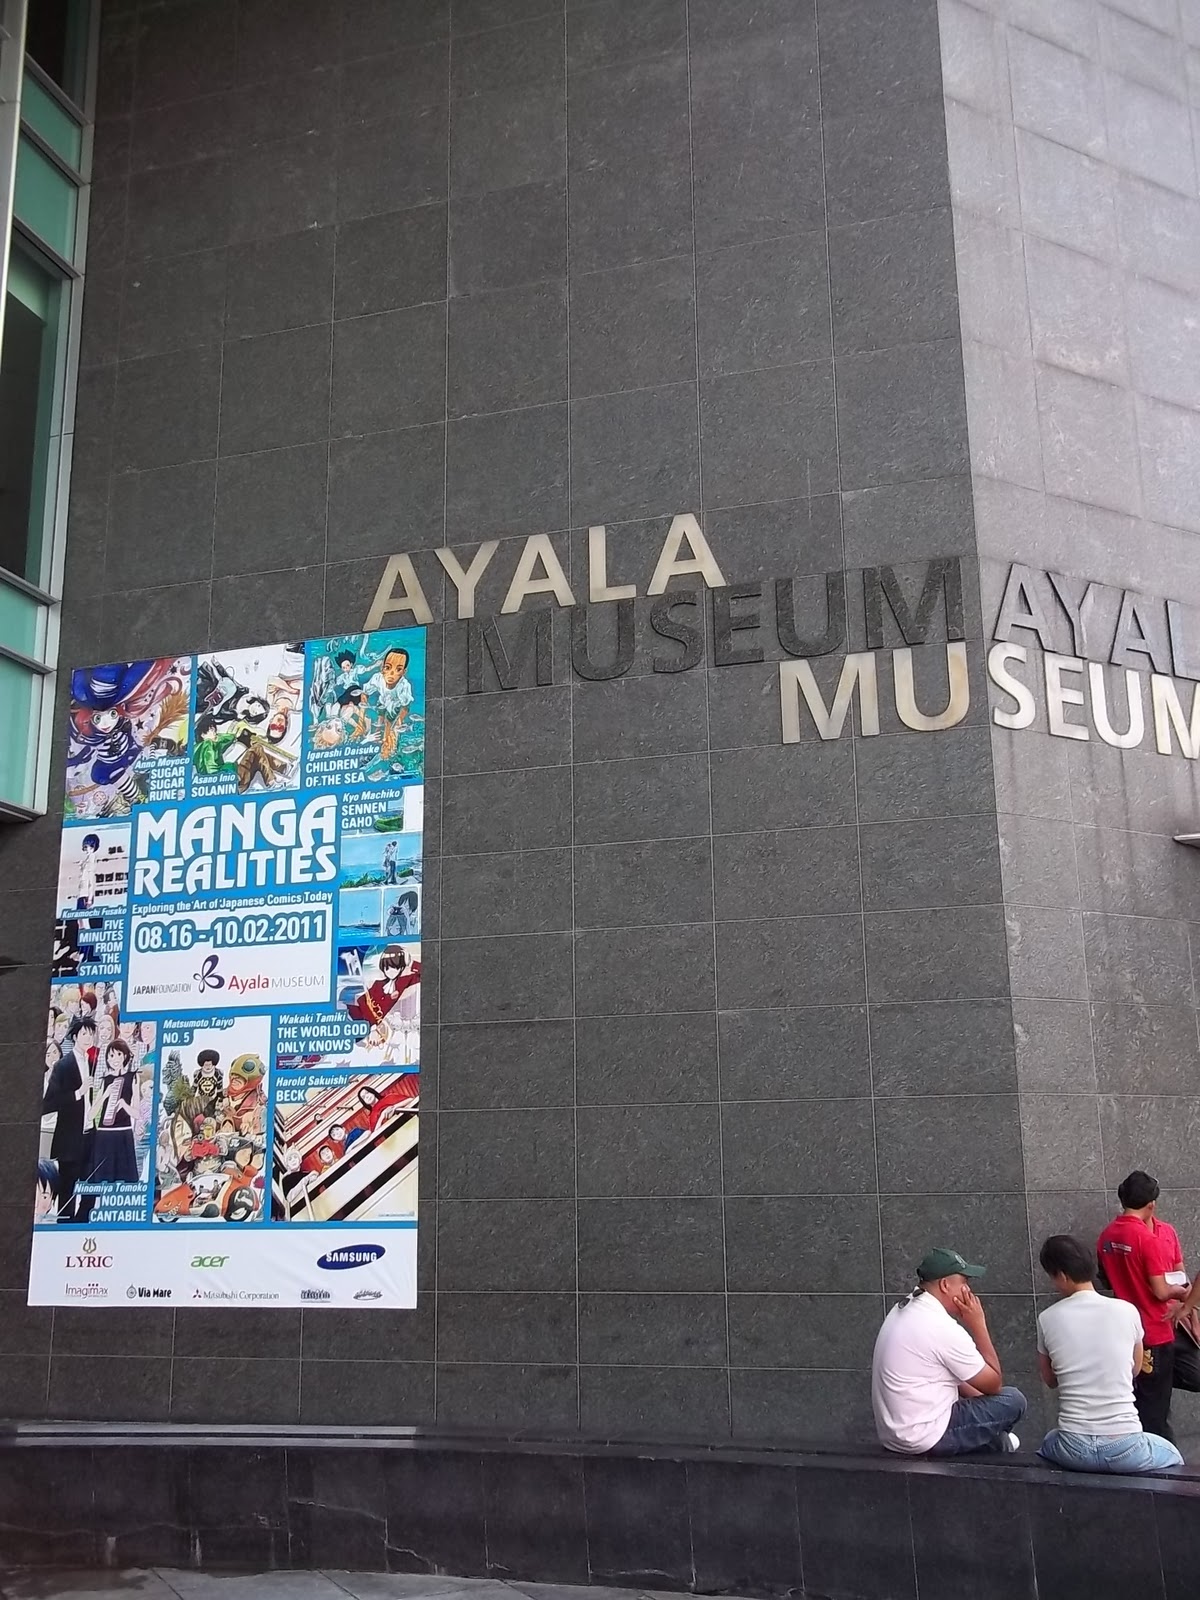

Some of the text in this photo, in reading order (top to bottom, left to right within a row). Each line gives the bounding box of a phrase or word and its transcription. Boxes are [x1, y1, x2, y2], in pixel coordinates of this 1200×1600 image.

[362, 513, 726, 632] AYALA
[468, 556, 965, 694] MUSEUM
[307, 745, 380, 761] Igarashi Daisuke
[135, 756, 190, 770] Anno Moyoco
[306, 758, 358, 773] CHILDREN
[151, 767, 185, 779] SUGAR
[192, 775, 217, 784] Asano
[306, 772, 365, 787] OF THE SEA
[150, 777, 185, 790] SUGAR
[150, 789, 177, 801] RUNE
[191, 784, 236, 797] SOLANIN
[342, 790, 400, 803] Kyo Machiko
[342, 802, 387, 816] SENNEN
[136, 795, 338, 860] MANGA
[342, 816, 372, 829] GAHO
[134, 845, 336, 898] REALITIES
[132, 891, 333, 916] Exploring the Art of Japanese Comics Today
[104, 919, 124, 930] FIVE
[79, 930, 123, 943] MINUTES
[95, 941, 123, 953] FROM
[101, 952, 120, 964] THE
[79, 963, 121, 976] STATION
[163, 1017, 234, 1029] Matsumoto Taiyo
[279, 1012, 346, 1025] Wakaki Tamiki
[277, 1024, 368, 1039] THE WORLD GOD
[277, 1039, 351, 1054] ONLY KNOWS
[276, 1074, 347, 1087] Harold Sakuishi
[277, 1089, 305, 1102] BECK
[74, 1182, 147, 1194] Ninomiya Tomoko
[102, 1194, 147, 1207] NODAME
[90, 1209, 147, 1222] CANTABILE
[66, 1256, 113, 1268] LYRIC
[190, 1256, 230, 1267] acer
[326, 1251, 378, 1263] SAMSUNG
[138, 1287, 172, 1298] Via Mare
[203, 1290, 279, 1301] Mitsubishi Corporation
